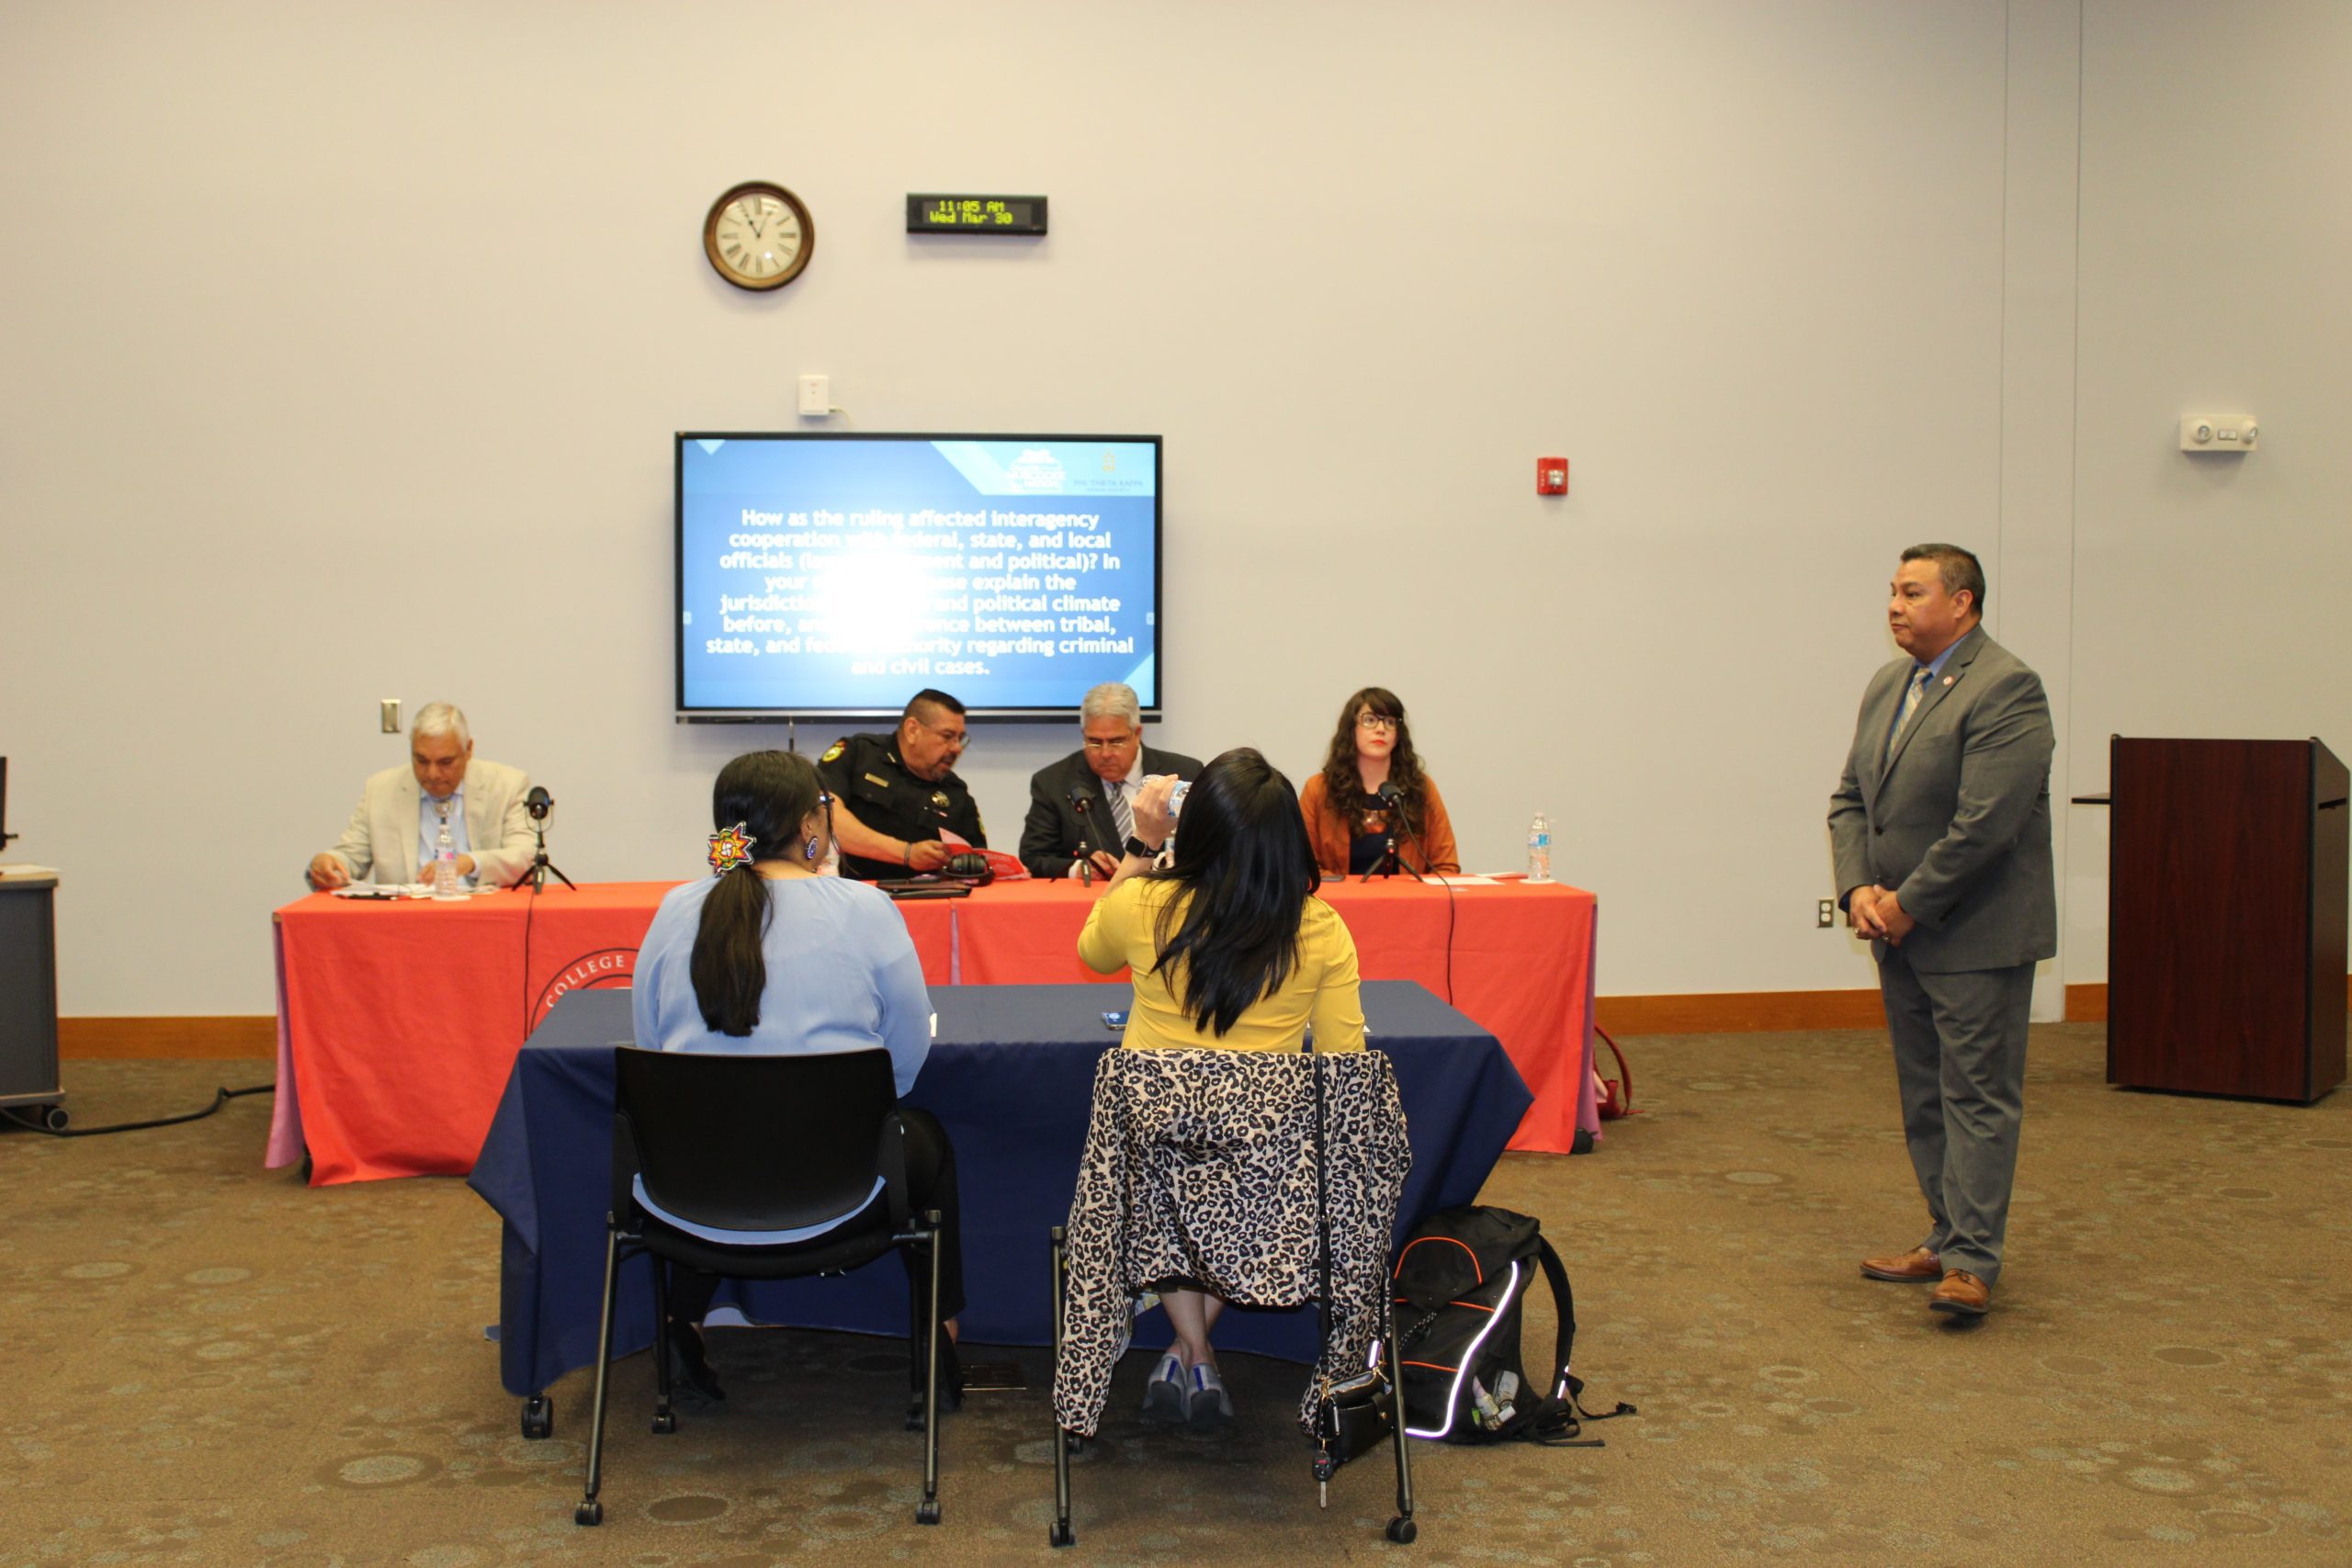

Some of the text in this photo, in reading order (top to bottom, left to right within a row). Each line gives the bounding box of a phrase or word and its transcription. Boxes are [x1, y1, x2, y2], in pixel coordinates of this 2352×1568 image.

[939, 200, 1005, 212] 11:05 AM
[929, 210, 956, 224] Wed
[962, 211, 989, 224] Mar
[741, 509, 1100, 530] How as the ruling affected interagency
[729, 531, 840, 549] cooperation
[969, 532, 1023, 550] state,
[1028, 531, 1063, 548] and
[1069, 531, 1112, 548] local
[720, 551, 793, 569] officials
[968, 553, 1003, 570] and
[1008, 552, 1097, 573] political)?
[1103, 554, 1121, 570] In
[764, 576, 808, 592] your
[972, 575, 1040, 592] explain
[1045, 574, 1077, 591] the
[935, 595, 968, 612] and
[973, 594, 1046, 615] political
[1052, 595, 1122, 612] climate
[723, 615, 792, 635] before,
[975, 616, 1055, 633] between
[1060, 616, 1116, 635] tribal,
[707, 637, 760, 655] state,
[765, 637, 800, 653] and
[967, 637, 1055, 657] regarding
[1059, 637, 1134, 653] criminal
[851, 659, 990, 675] and civil cases.
[546, 955, 624, 1008] COLLEGE
